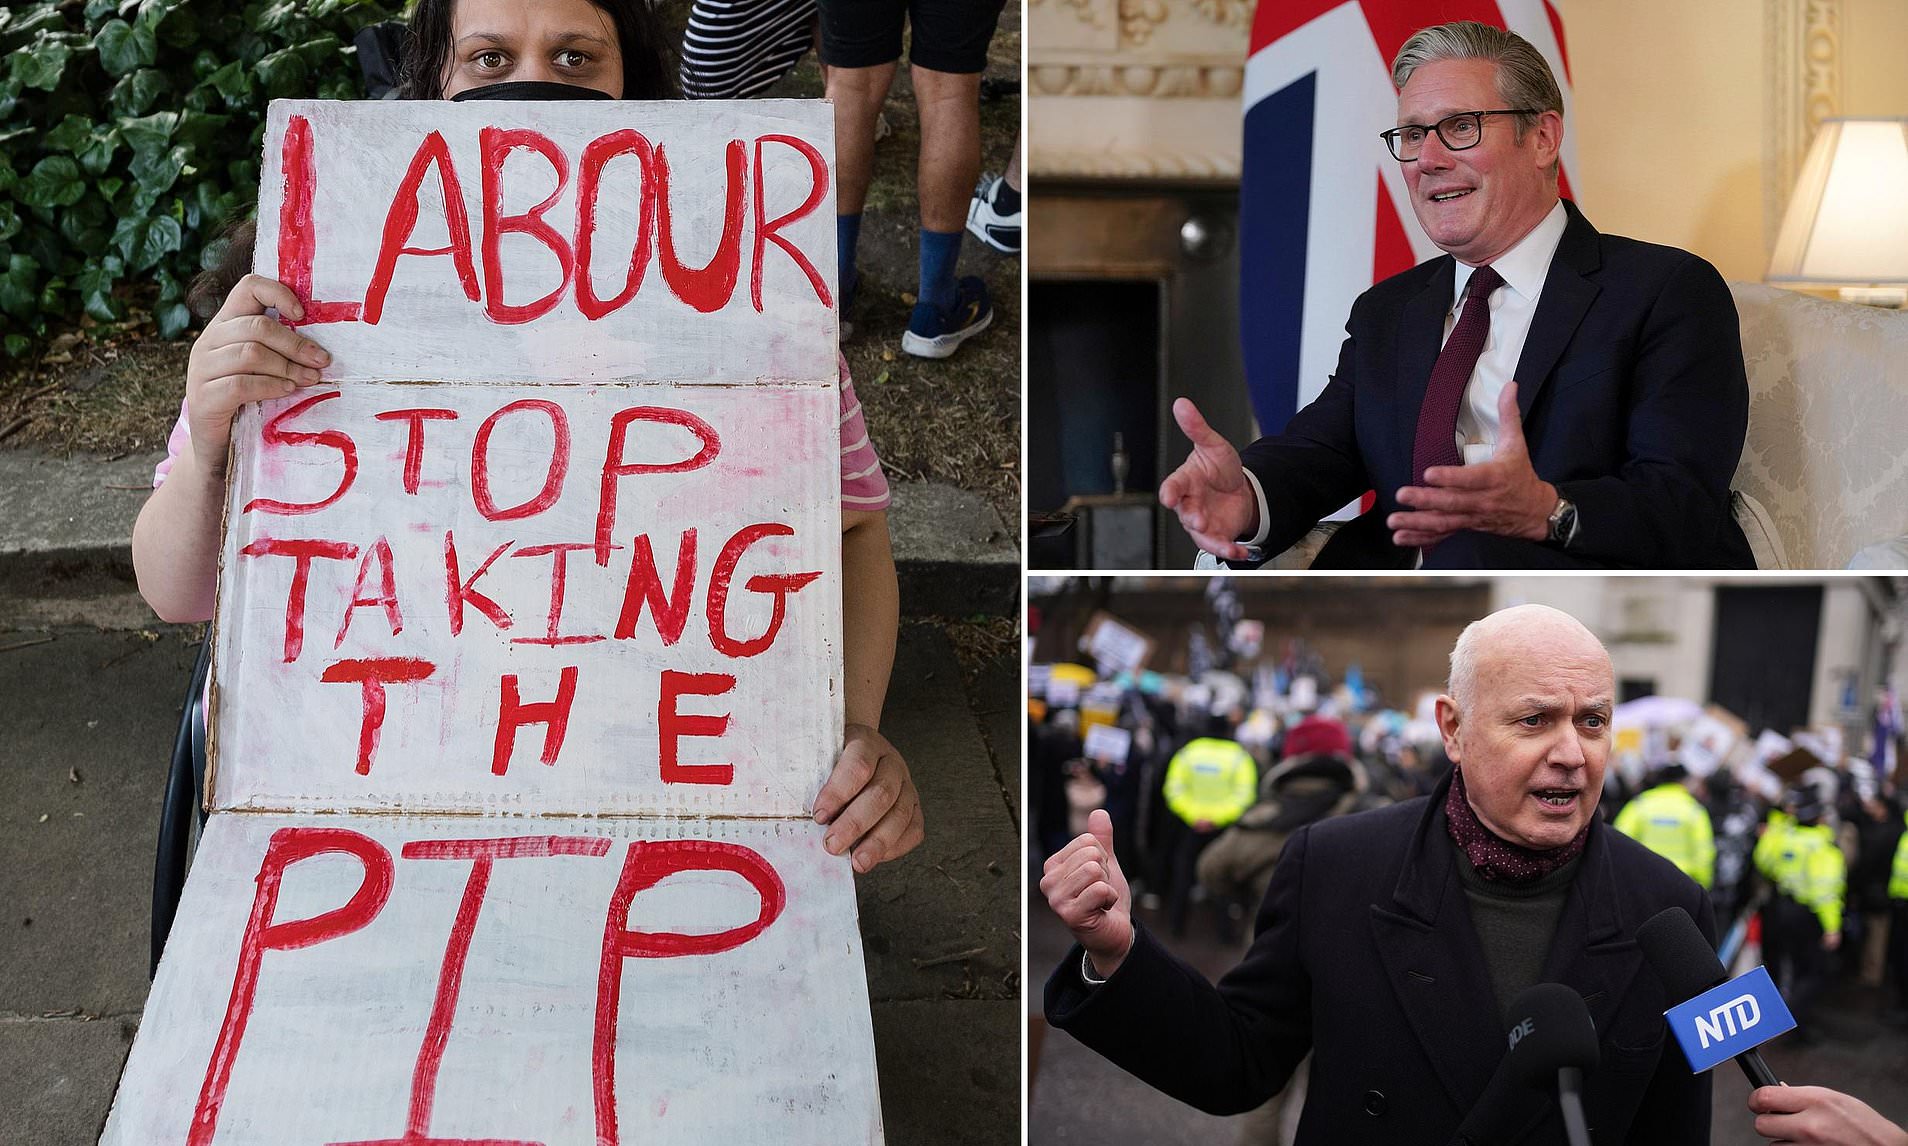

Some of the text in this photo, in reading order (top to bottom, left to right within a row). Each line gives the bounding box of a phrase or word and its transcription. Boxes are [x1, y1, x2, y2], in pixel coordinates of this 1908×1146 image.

[278, 114, 833, 326] LABOUR
[243, 391, 720, 567] STOP
[240, 523, 823, 663] TAKING
[320, 657, 737, 786] THE
[187, 826, 787, 1146] PIP
[1695, 993, 1761, 1049] NTD
